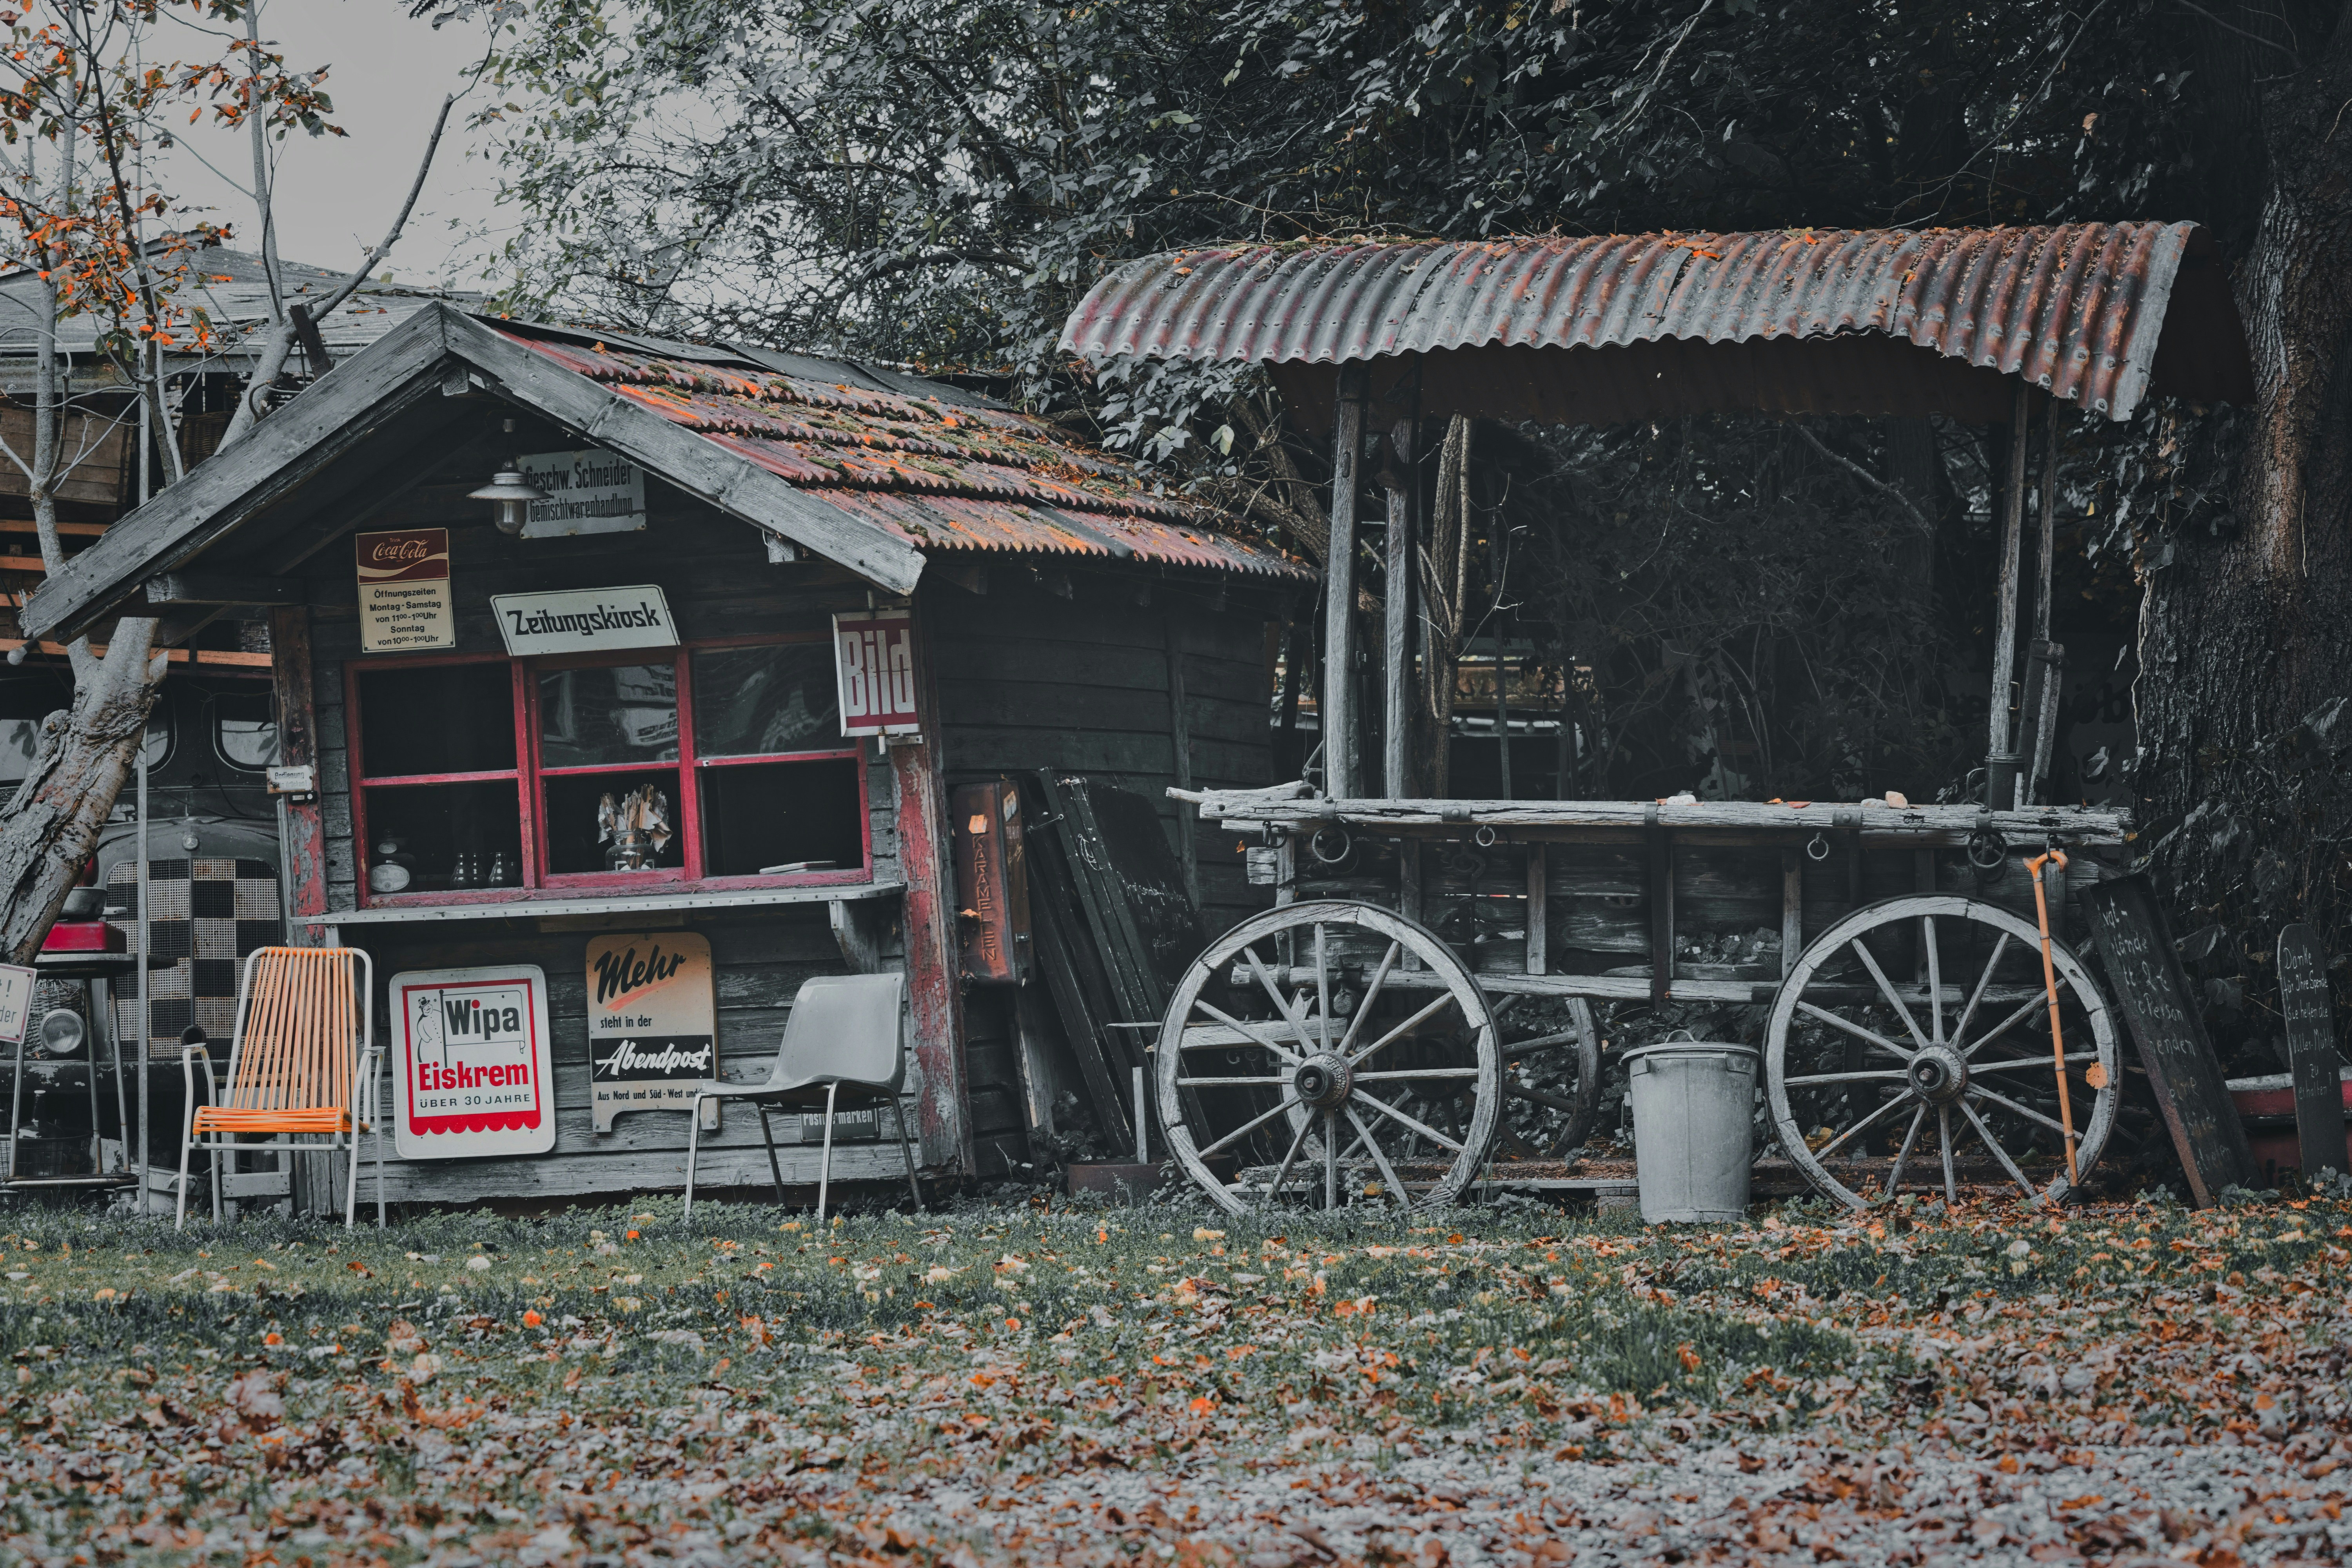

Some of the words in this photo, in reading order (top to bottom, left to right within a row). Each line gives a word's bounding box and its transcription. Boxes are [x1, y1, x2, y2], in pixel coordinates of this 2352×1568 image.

[526, 464, 572, 491] Geschw.
[575, 459, 633, 489] Schneider
[530, 493, 633, 523] Gemischtwarenhandlung
[373, 539, 429, 561] Coca-Cola
[374, 588, 436, 598] Öffnungszeiten
[506, 602, 661, 636] Zeitungskiosk
[839, 629, 915, 717] Bild
[972, 836, 996, 960] KARAMELLEN
[594, 944, 686, 1004] Mehr
[2284, 976, 2294, 1000] für
[2296, 973, 2309, 991] Ihre
[2310, 969, 2328, 994] Spende
[445, 1000, 521, 1040] Wipa
[601, 1016, 621, 1028] steht
[626, 1016, 633, 1027] in
[638, 1014, 652, 1027] der
[594, 1039, 711, 1078] Abendpost
[419, 1061, 528, 1091] Eiskrem
[420, 1098, 457, 1108] ÜBER
[465, 1096, 481, 1105] 30
[485, 1094, 530, 1104] JAHRE
[598, 1091, 610, 1100] Aus
[613, 1090, 629, 1100] Nord
[633, 1090, 646, 1099] und
[668, 1089, 683, 1098] West
